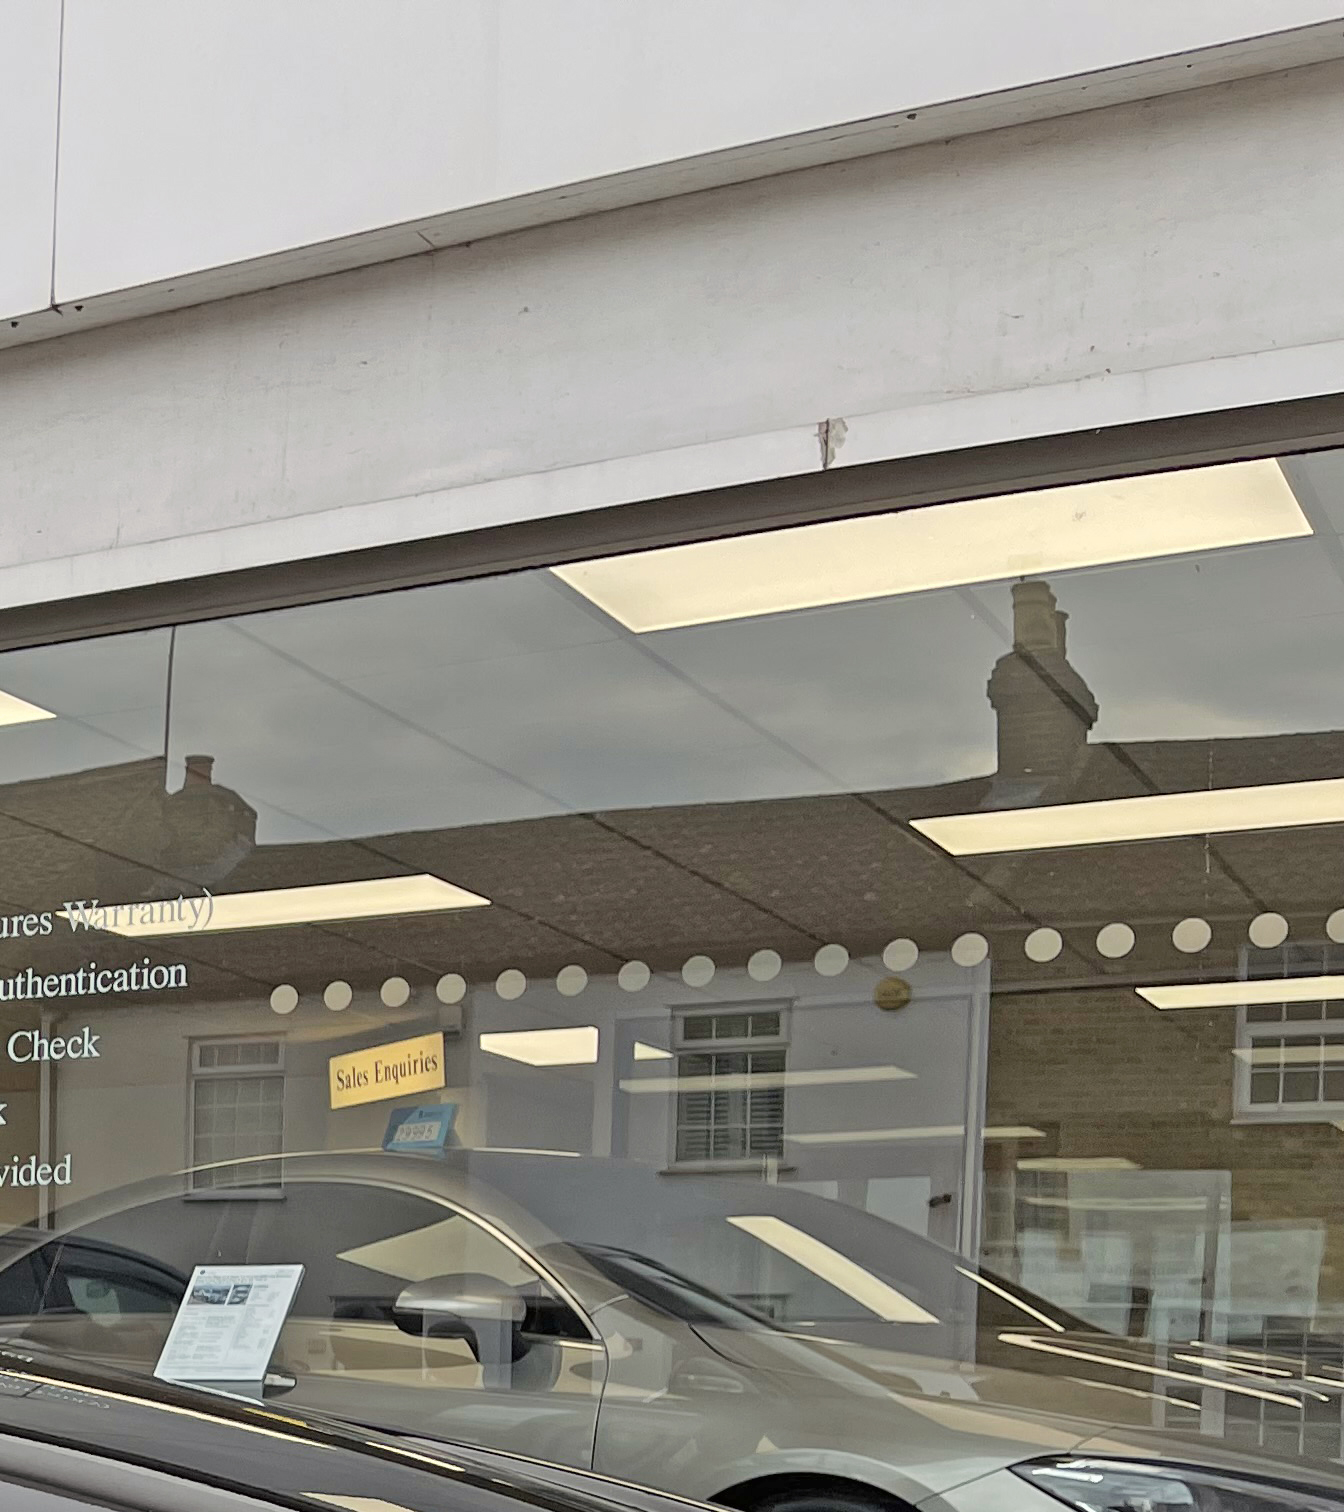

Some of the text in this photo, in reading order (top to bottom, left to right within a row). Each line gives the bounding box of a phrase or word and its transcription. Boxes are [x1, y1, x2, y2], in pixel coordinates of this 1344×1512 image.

[63, 887, 214, 934] Warranty)
[7, 1027, 101, 1061] Check
[336, 1050, 438, 1091] Sales Enquiries
